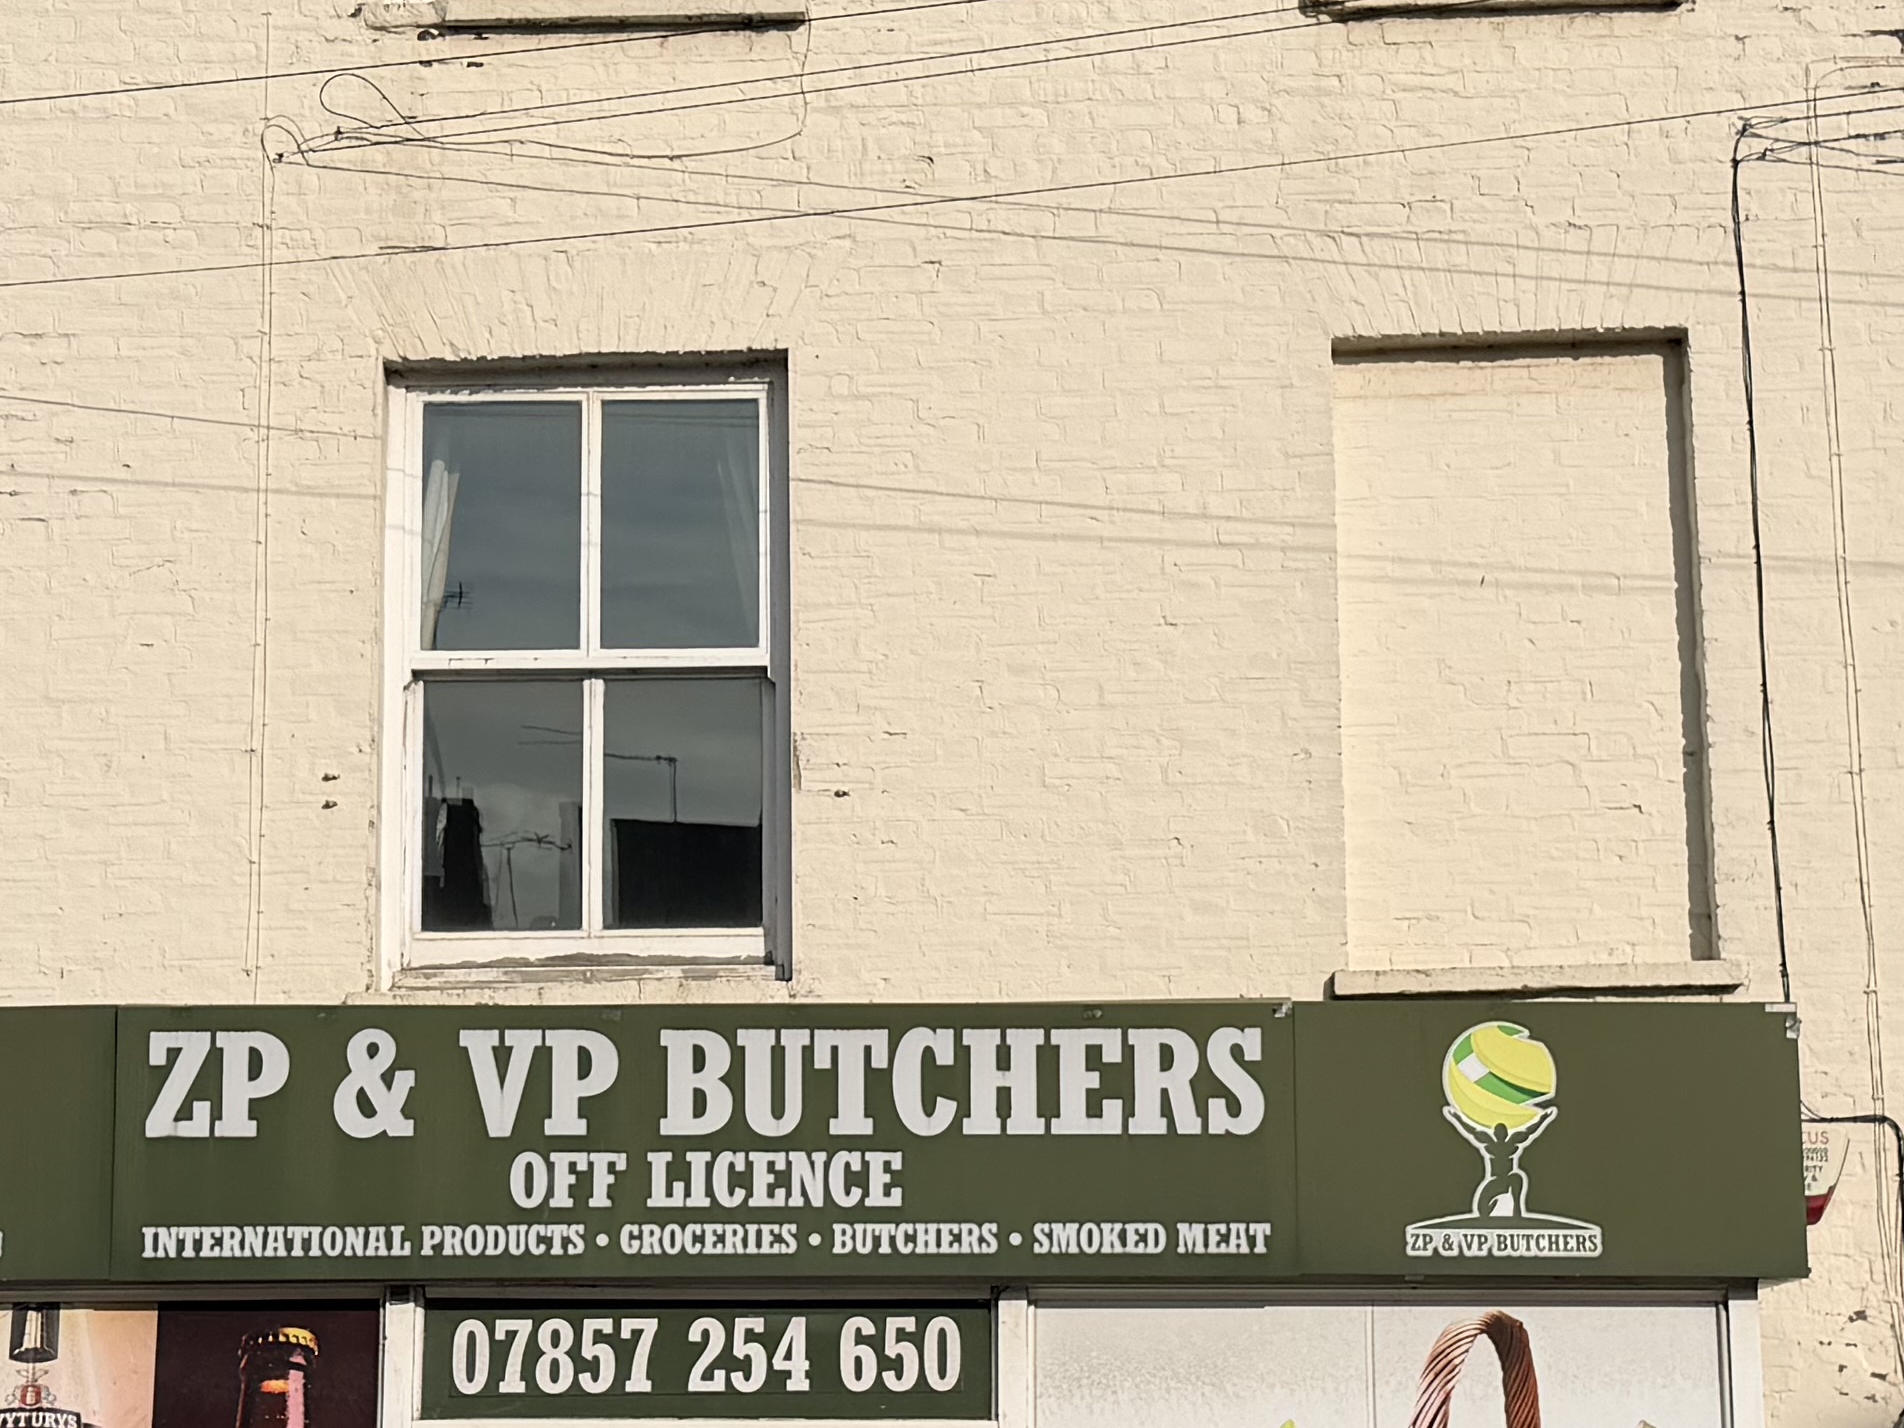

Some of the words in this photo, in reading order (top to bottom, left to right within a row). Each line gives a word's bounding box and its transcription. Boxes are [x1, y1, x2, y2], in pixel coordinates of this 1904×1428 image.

[145, 1030, 290, 1138] ZP
[333, 1028, 416, 1139] &
[459, 1029, 619, 1138] VP
[659, 1026, 1266, 1137] BUTCHERS
[509, 1151, 627, 1209] OFF
[646, 1150, 903, 1208] LICENCE
[141, 1225, 412, 1259] INTERNATIONAL
[420, 1223, 585, 1256] PRODUCTS
[619, 1223, 798, 1255] GROCERIES
[831, 1222, 999, 1255] BUTCHERS
[1033, 1222, 1167, 1255] SMOKED
[1176, 1222, 1271, 1254] MEAT
[1410, 1234, 1434, 1251] ZP
[1442, 1234, 1454, 1252] &
[1462, 1234, 1488, 1252] VP
[1496, 1234, 1598, 1252] BUTCHERS
[452, 1317, 659, 1395] 07857
[687, 1316, 810, 1393] 254
[839, 1315, 961, 1392] 650
